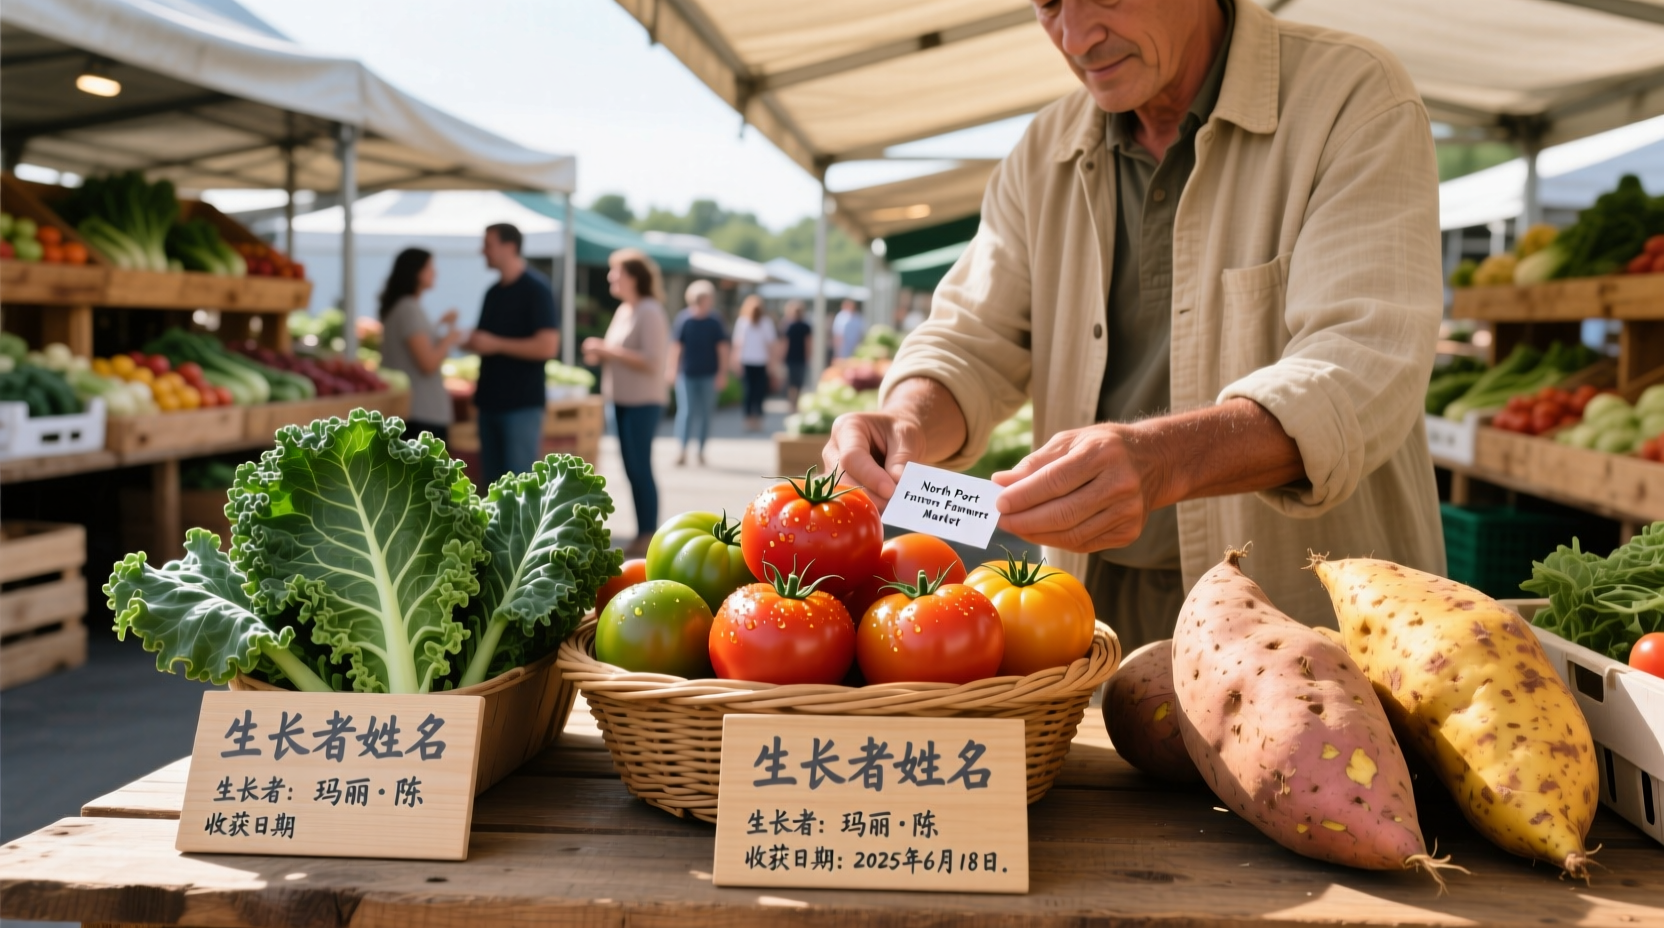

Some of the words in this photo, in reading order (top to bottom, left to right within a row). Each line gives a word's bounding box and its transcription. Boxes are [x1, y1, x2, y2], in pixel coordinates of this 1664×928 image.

[921, 480, 951, 497] North
[954, 489, 980, 503] Port
[220, 709, 447, 762] 生长者姓名
[753, 735, 992, 792] 生长者姓名
[204, 812, 296, 839] 收获日期
